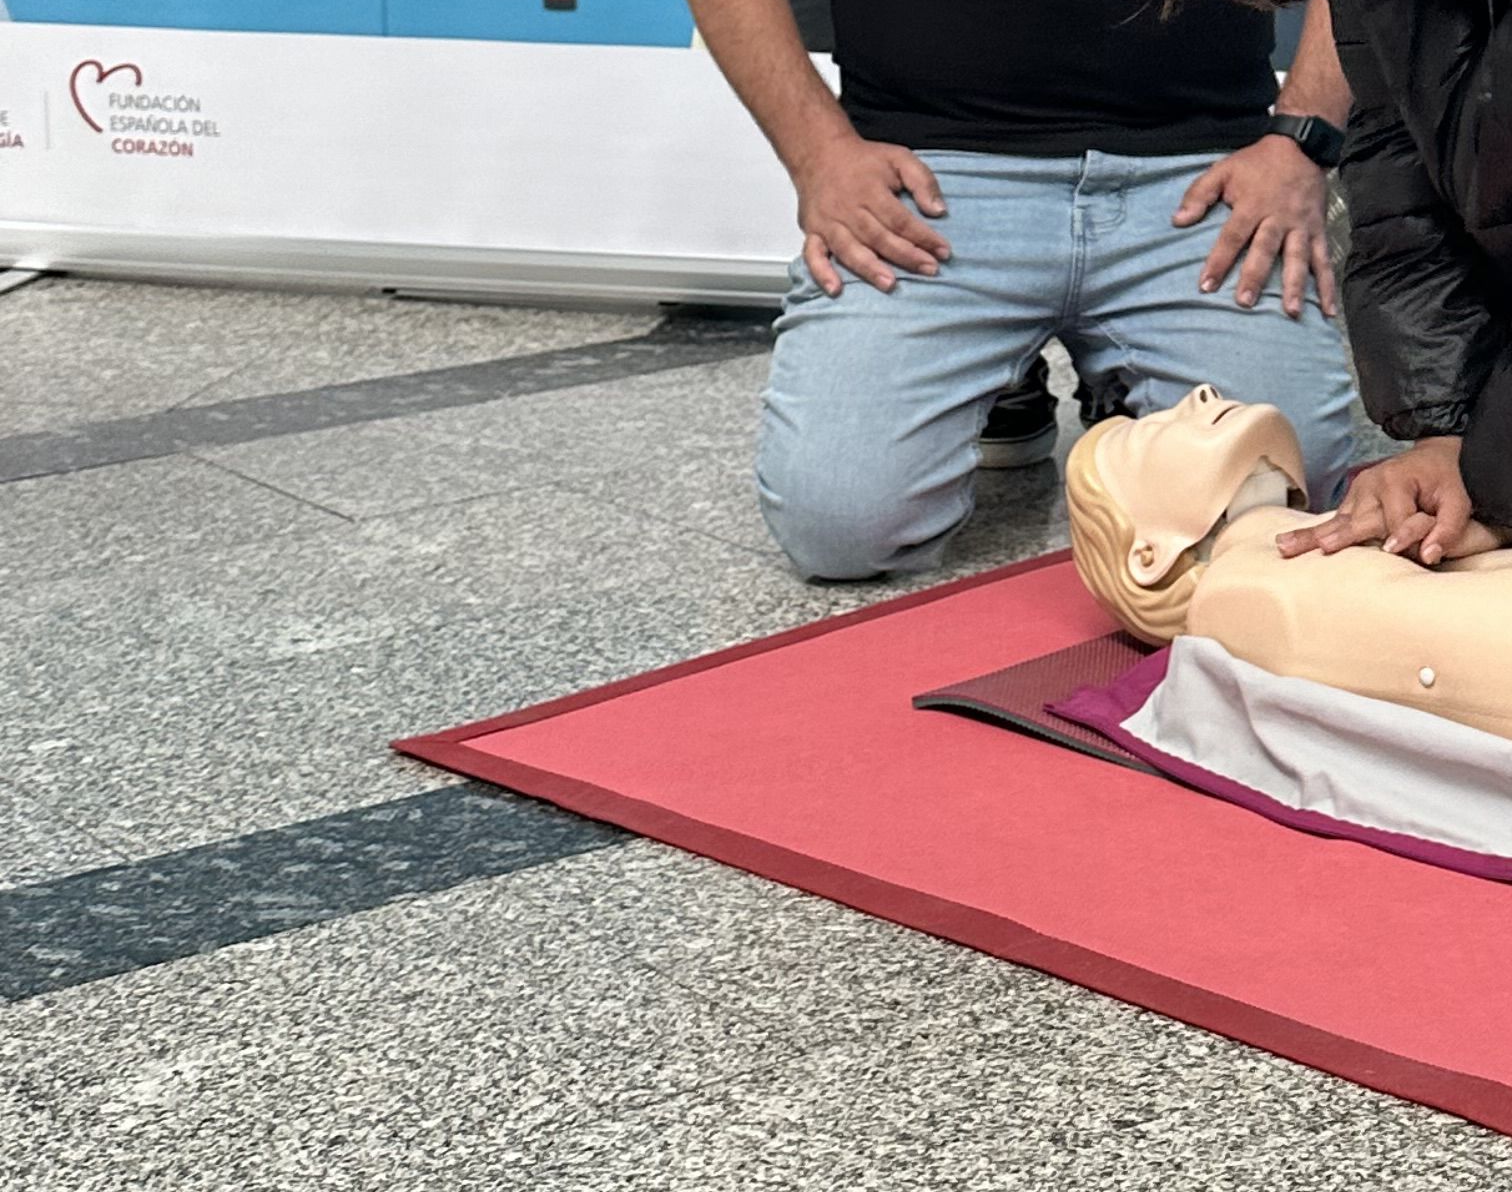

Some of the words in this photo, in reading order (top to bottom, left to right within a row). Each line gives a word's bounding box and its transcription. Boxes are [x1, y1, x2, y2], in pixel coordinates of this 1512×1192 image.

[109, 92, 202, 113] FUNDACIÓN
[109, 114, 188, 136] ESPAÑOLA
[192, 119, 221, 137] DEL
[111, 137, 194, 158] CORAZÓN
